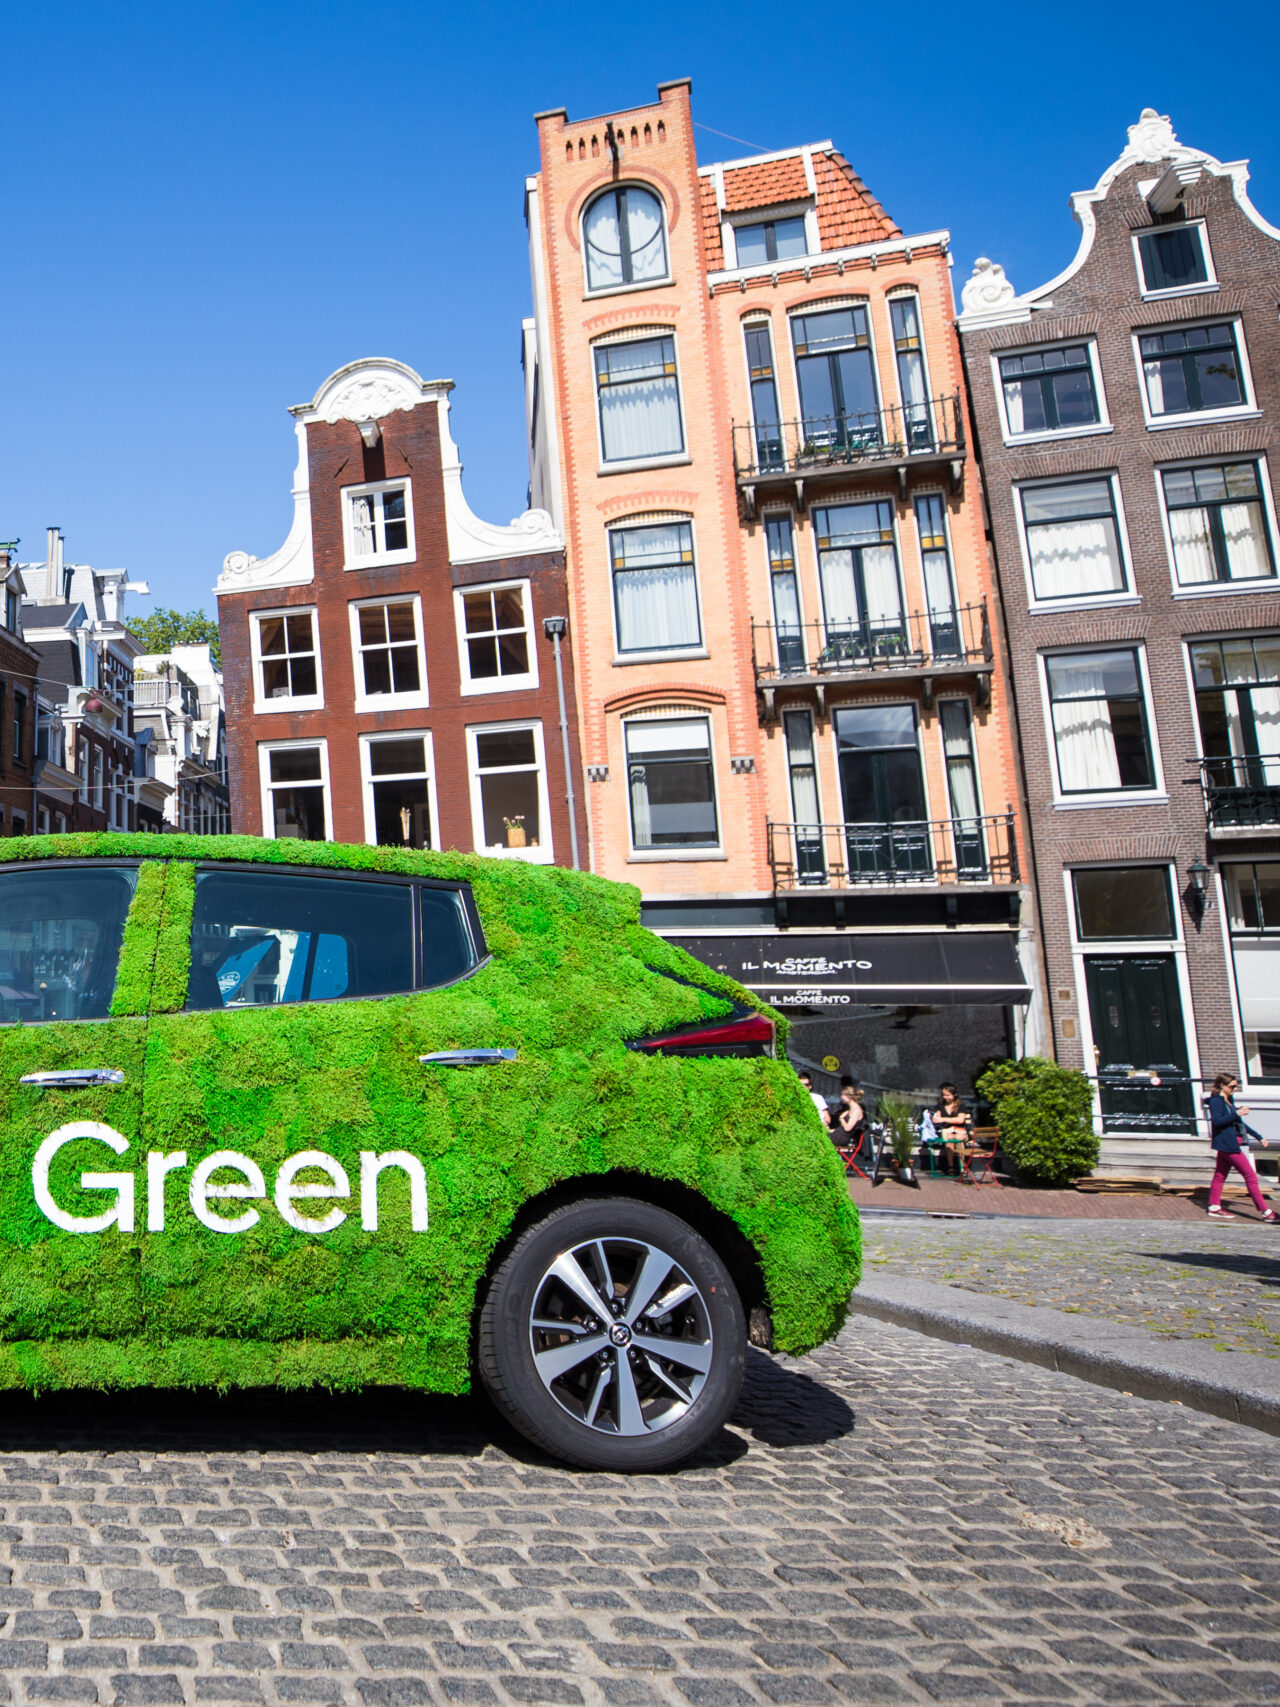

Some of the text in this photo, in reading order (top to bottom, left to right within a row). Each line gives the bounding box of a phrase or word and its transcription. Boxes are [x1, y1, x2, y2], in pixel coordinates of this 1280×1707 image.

[742, 960, 873, 971] IL MOMENTO
[769, 995, 851, 1004] IL MOMENTO
[31, 1120, 430, 1234] Green
